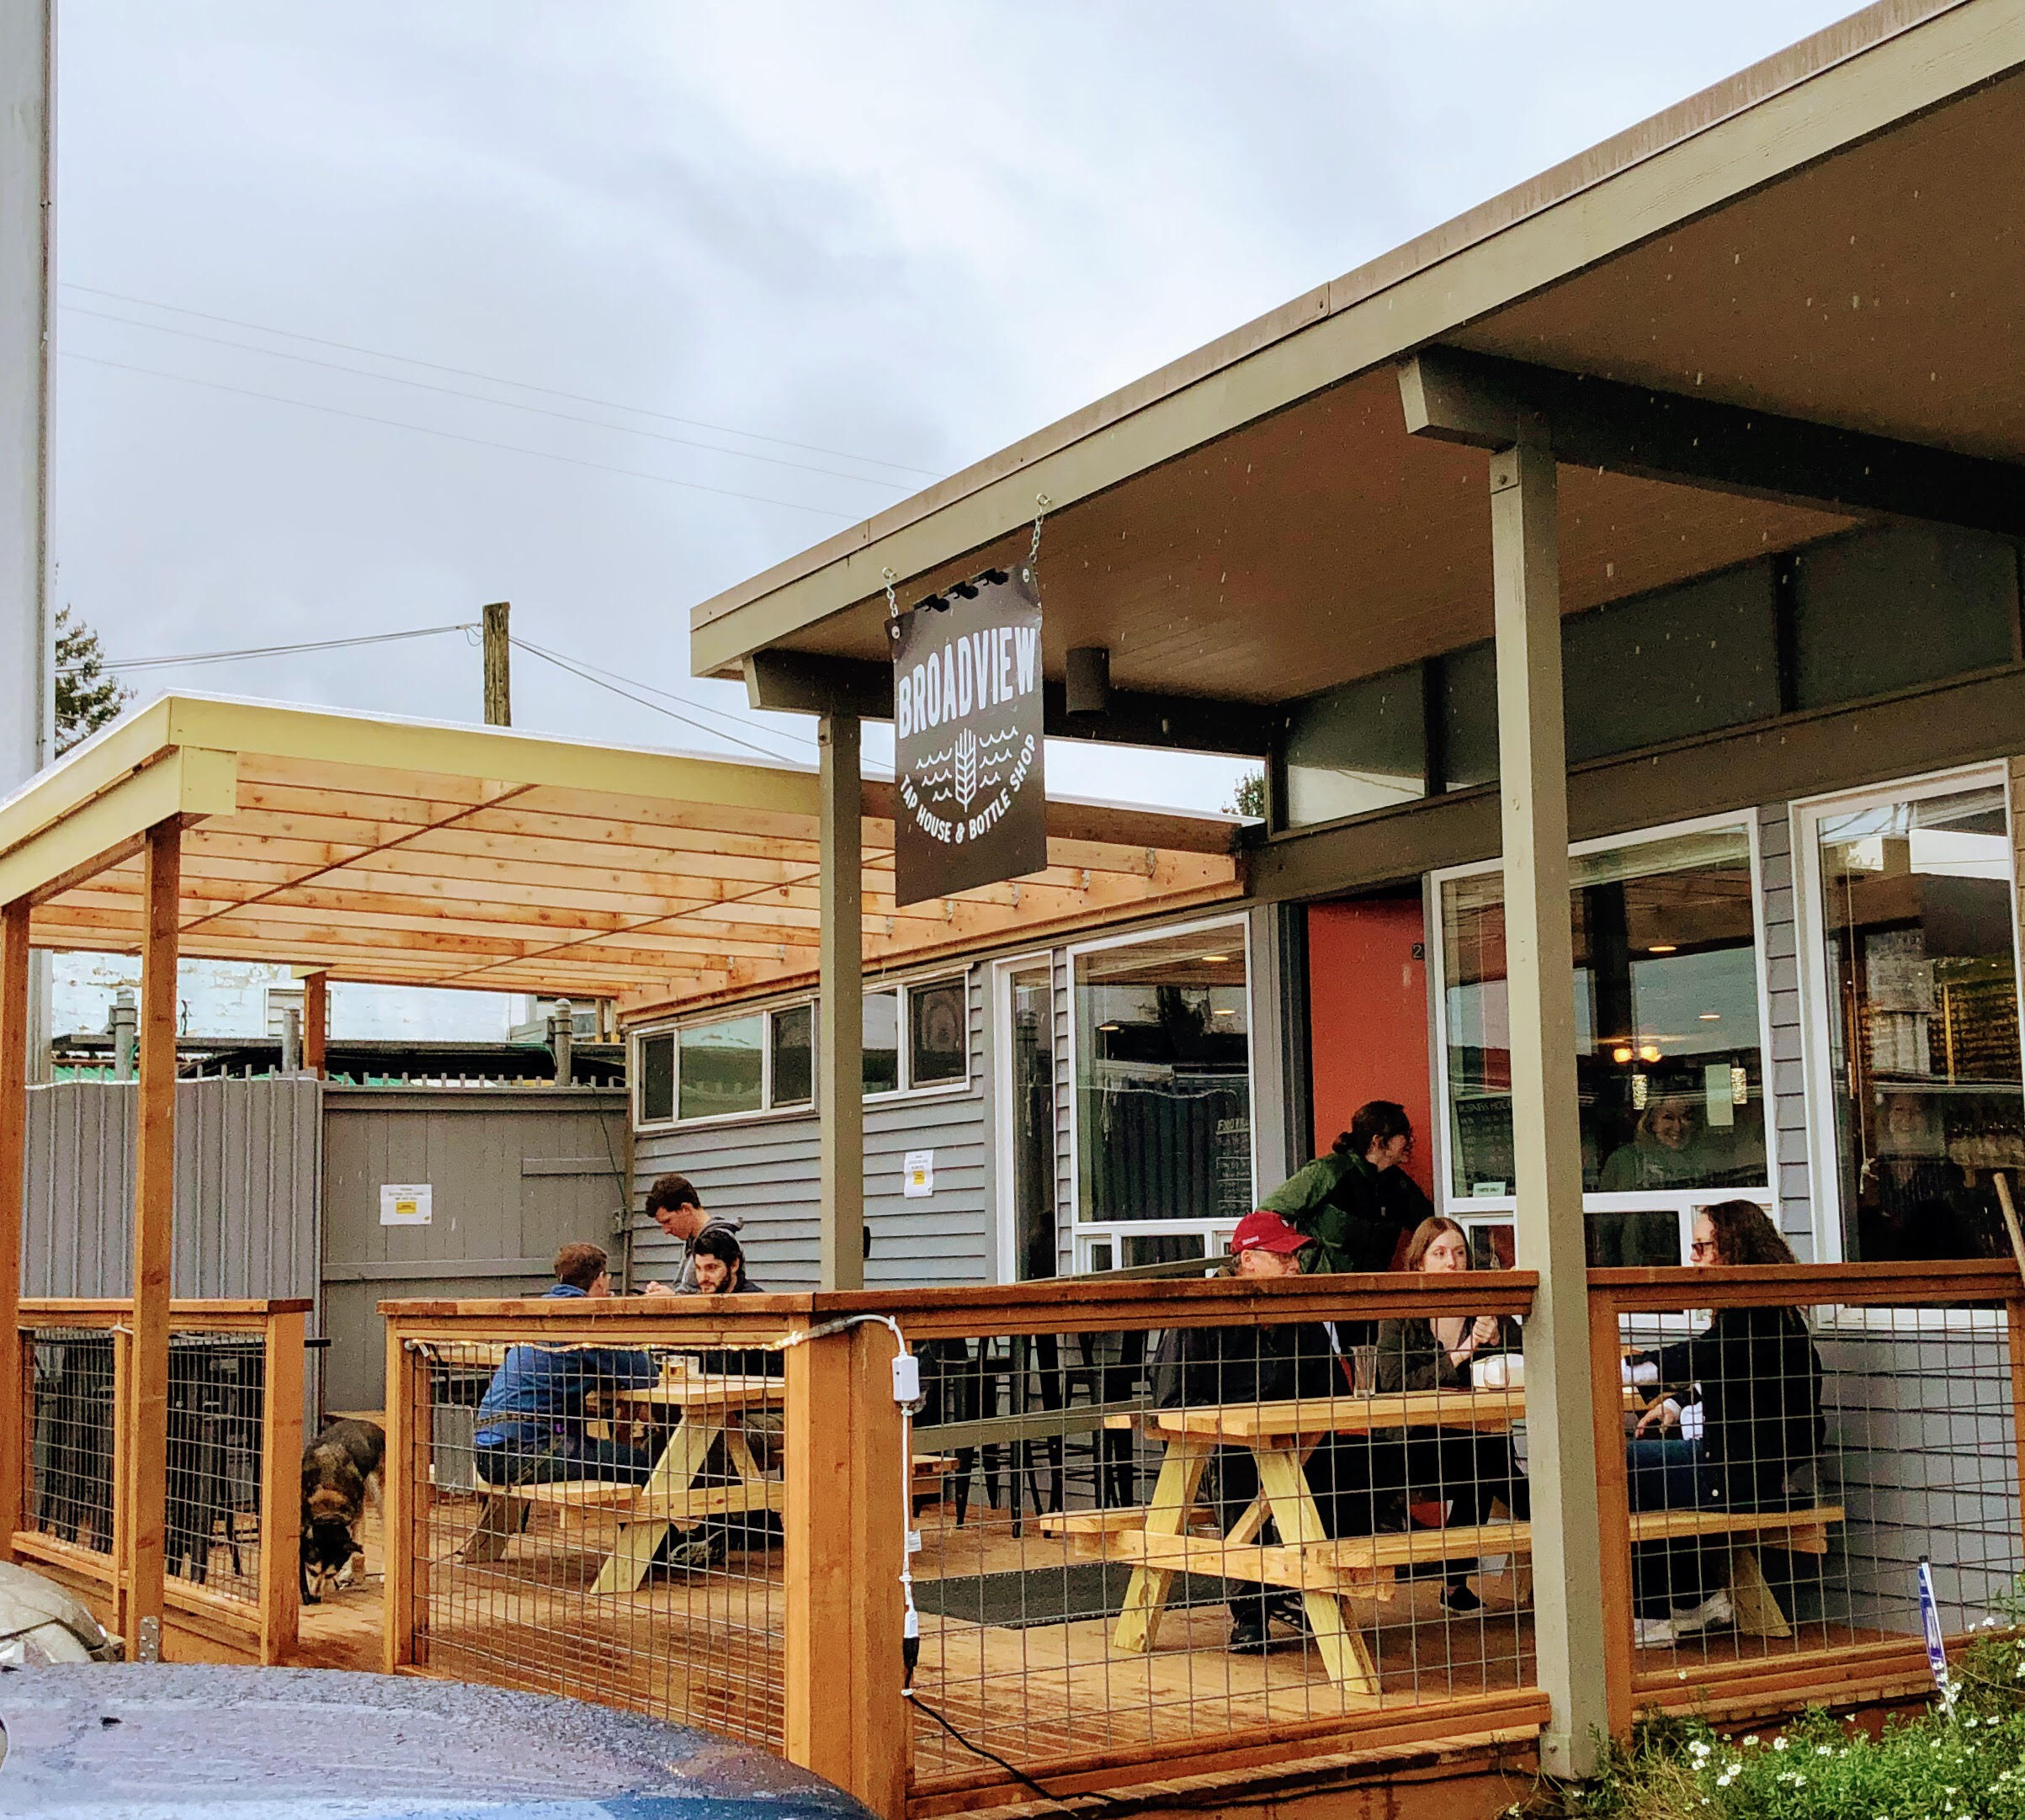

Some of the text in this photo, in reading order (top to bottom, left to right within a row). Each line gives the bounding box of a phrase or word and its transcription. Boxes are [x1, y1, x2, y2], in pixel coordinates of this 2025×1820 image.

[898, 626, 1036, 740] BROADVIEW
[900, 733, 1036, 844] TAP HOUSE & BOTTLE SHOP
